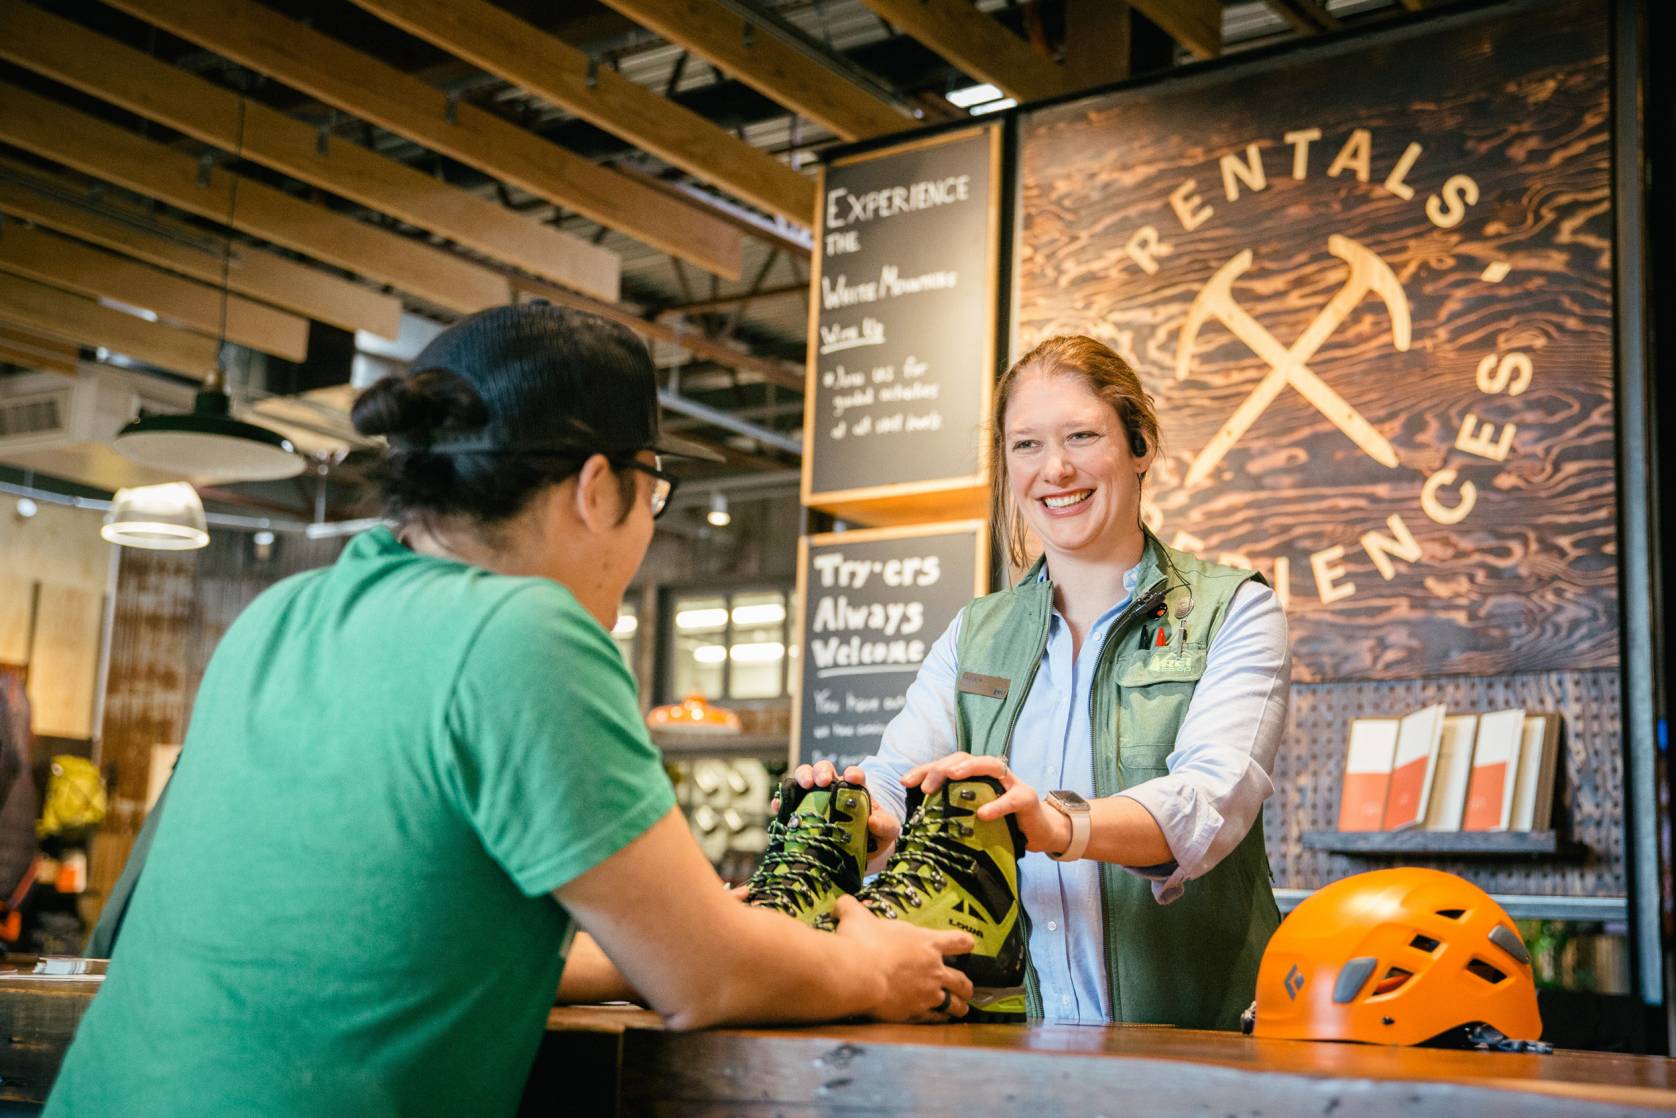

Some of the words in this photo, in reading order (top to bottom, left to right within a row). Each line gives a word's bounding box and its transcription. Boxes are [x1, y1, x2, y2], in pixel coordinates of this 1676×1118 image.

[826, 174, 971, 229] EXPERIENCE
[1124, 128, 1479, 275] RENTALS
[825, 230, 861, 257] THE
[1142, 350, 1534, 606] IENCES
[812, 595, 925, 636] Always
[811, 635, 926, 669] Welcome
[948, 918, 984, 938] LOWA
